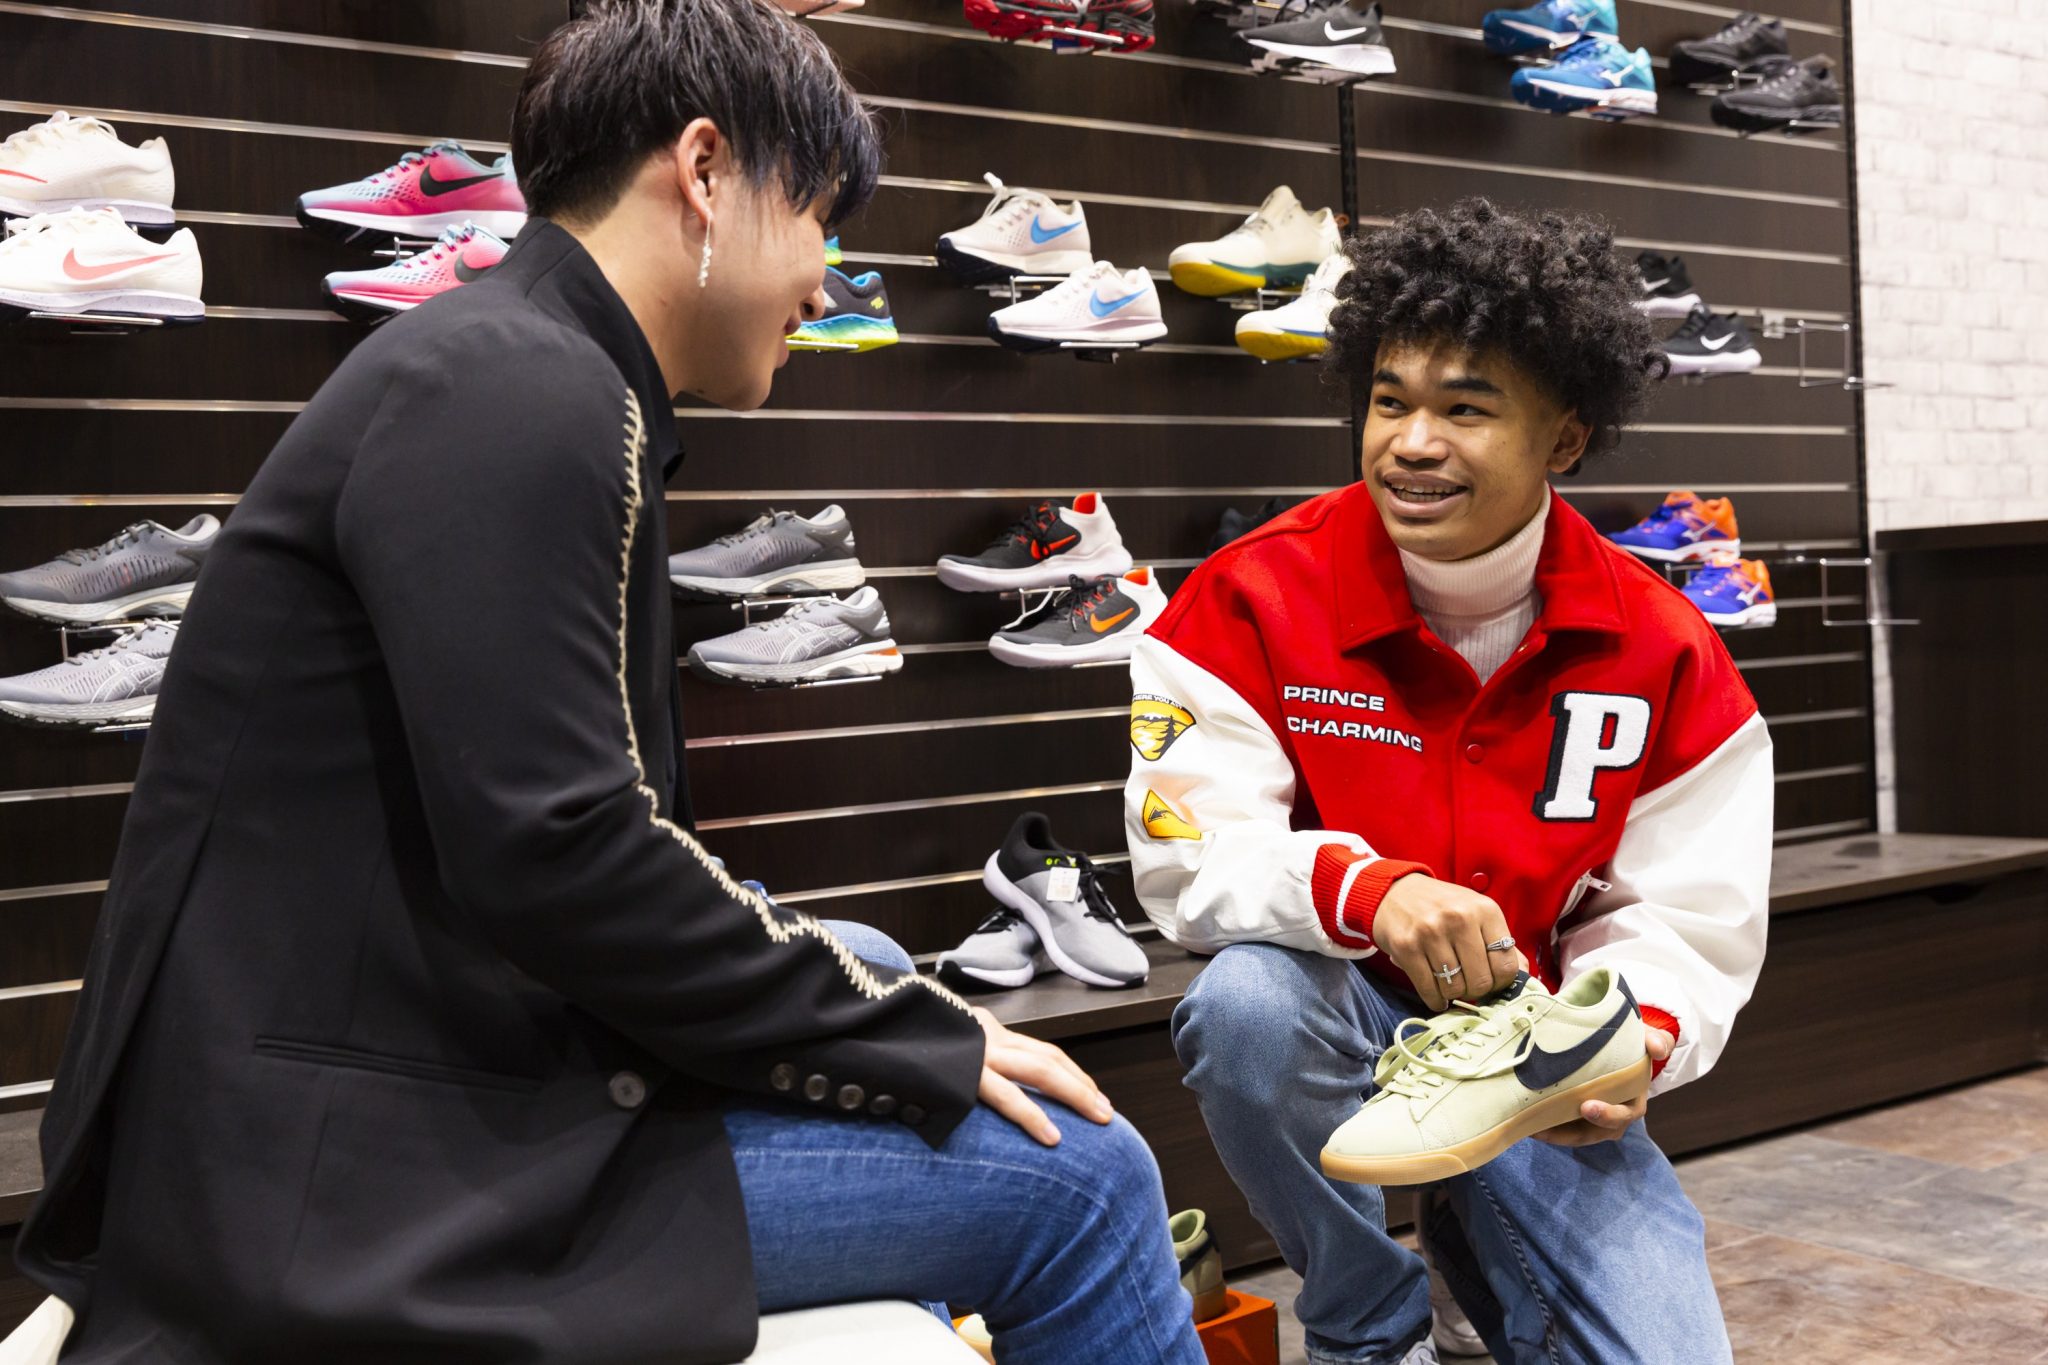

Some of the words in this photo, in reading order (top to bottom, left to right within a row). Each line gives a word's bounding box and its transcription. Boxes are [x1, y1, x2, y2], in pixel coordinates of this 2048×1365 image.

[1283, 685, 1385, 712] PRINCE
[1286, 715, 1423, 753] CHARMING
[1533, 691, 1652, 822] P
